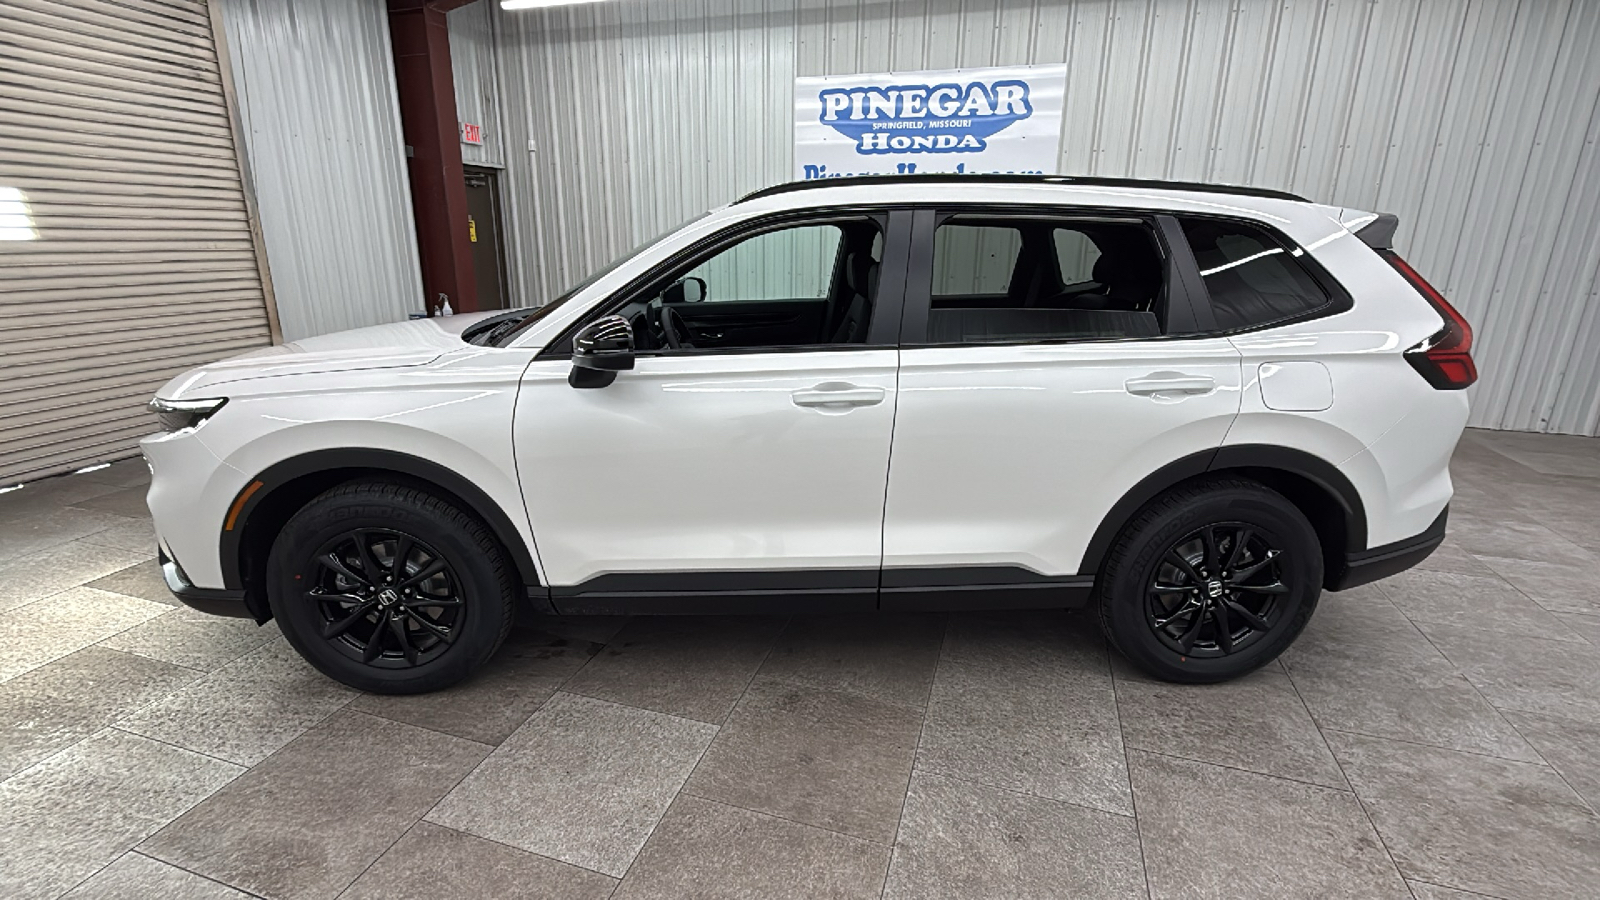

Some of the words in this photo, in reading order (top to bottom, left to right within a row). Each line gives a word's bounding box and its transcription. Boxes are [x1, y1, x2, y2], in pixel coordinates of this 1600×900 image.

[822, 84, 1028, 121] PINEGAR
[465, 123, 480, 143] EXIT
[872, 121, 926, 130] SPRINGFIELD,
[929, 119, 972, 129] MISSOURI
[860, 133, 983, 150] HONDA
